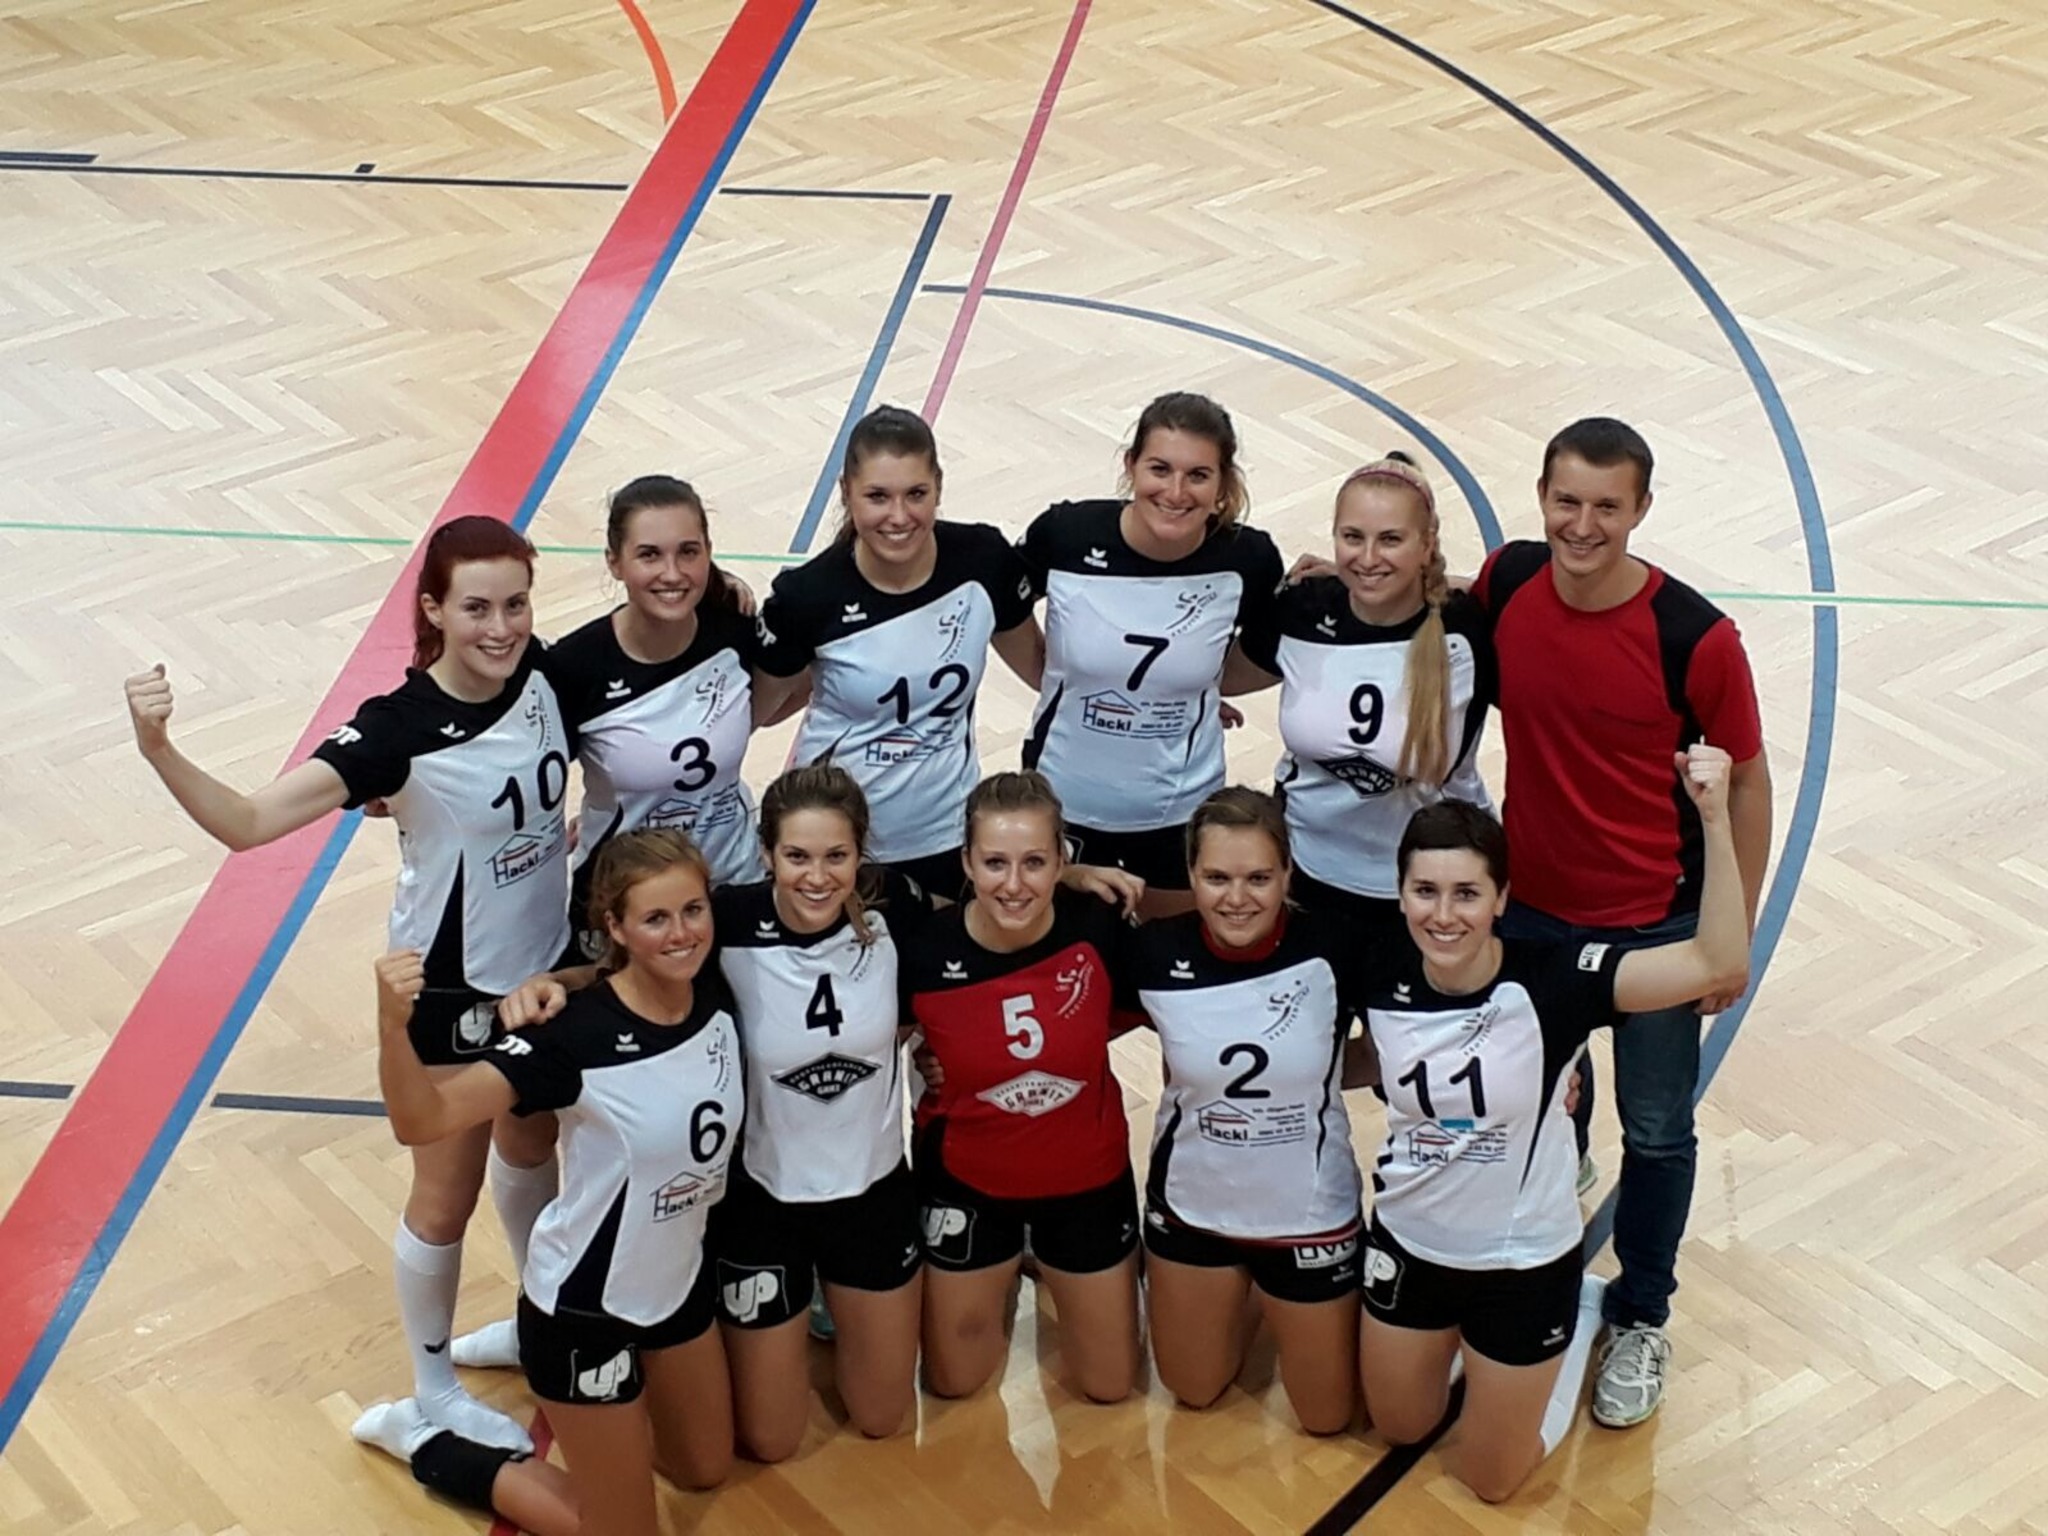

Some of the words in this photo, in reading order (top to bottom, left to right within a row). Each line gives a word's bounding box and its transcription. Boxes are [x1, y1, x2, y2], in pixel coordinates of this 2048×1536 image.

[1124, 633, 1170, 691] 7
[877, 663, 970, 724] 12
[1348, 683, 1384, 745] 9
[491, 750, 567, 831] 10
[670, 737, 717, 791] 3
[806, 973, 843, 1037] 4
[1002, 994, 1044, 1060] 5
[1219, 1043, 1271, 1098] 2
[1398, 1056, 1486, 1118] 11
[690, 1100, 726, 1163] 6
